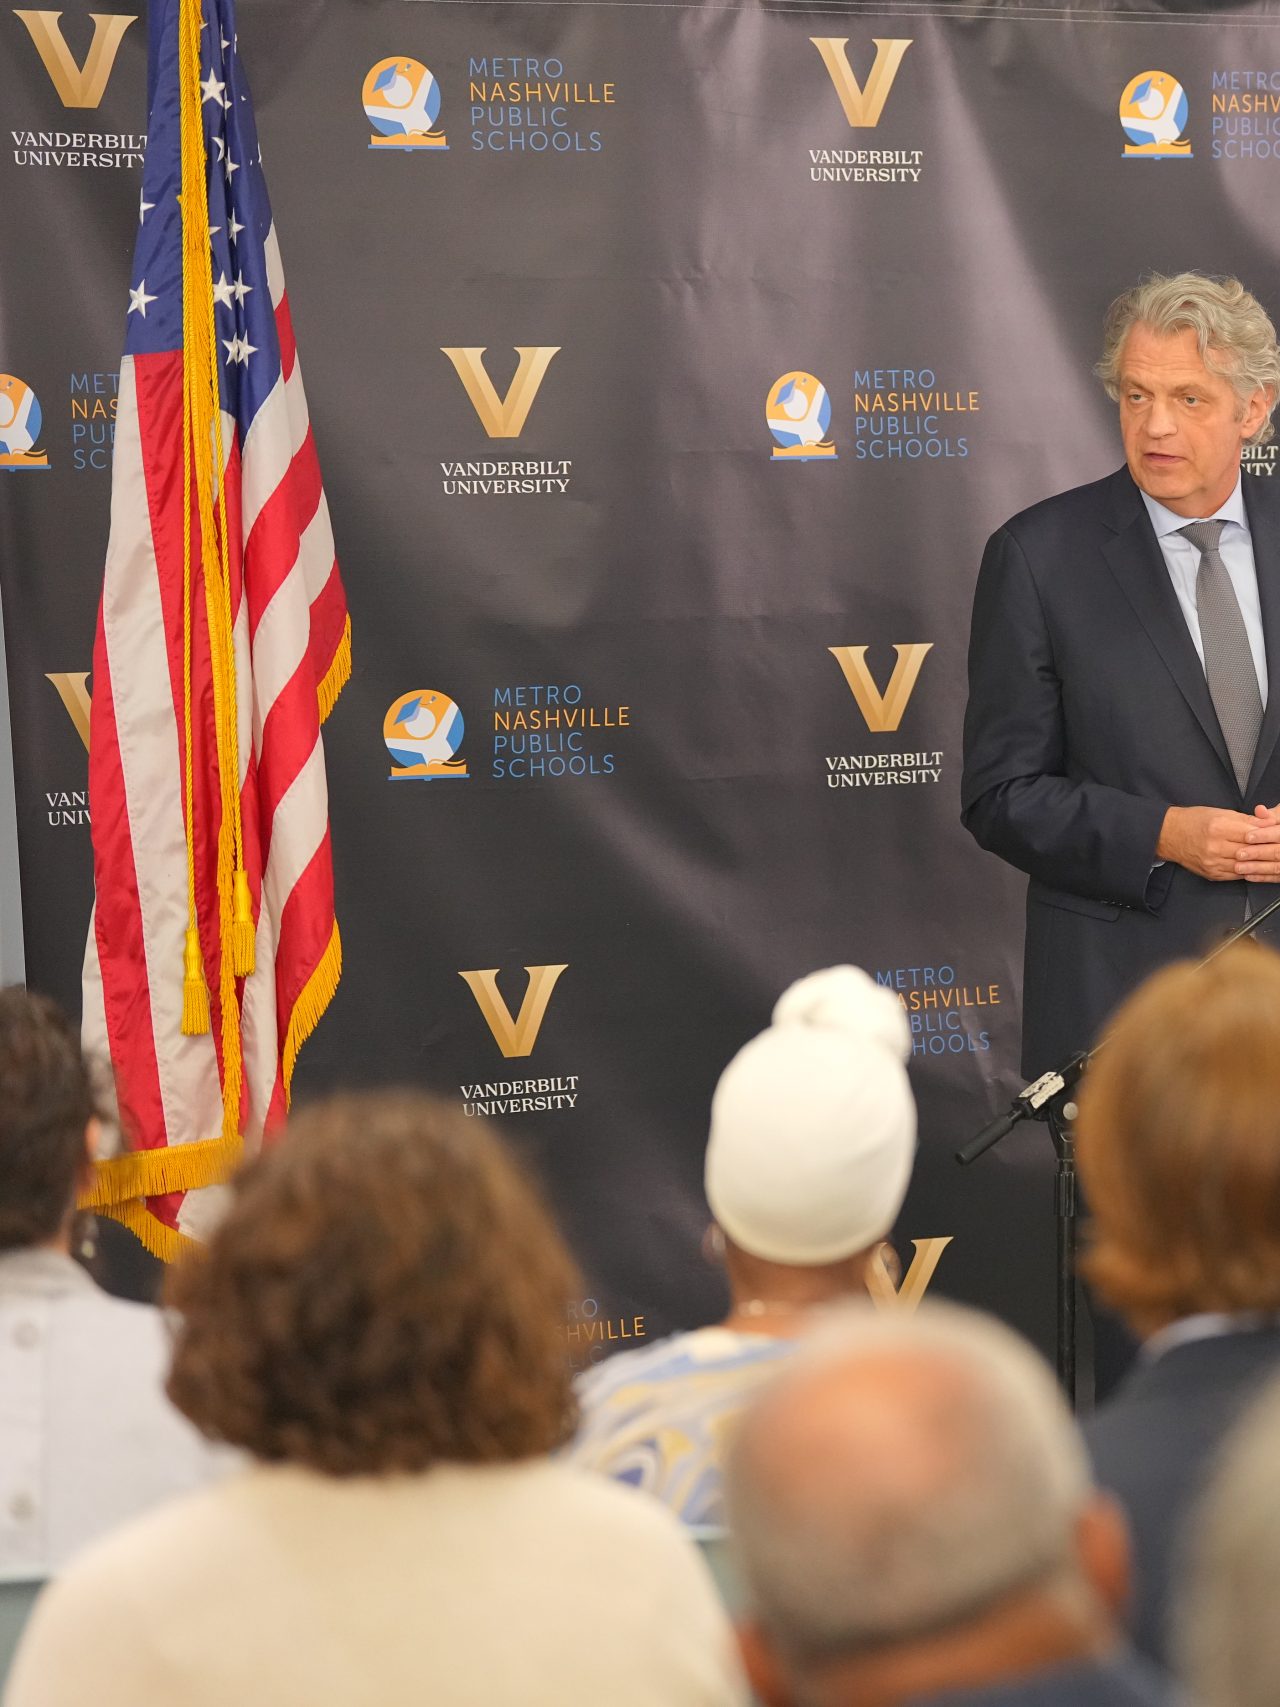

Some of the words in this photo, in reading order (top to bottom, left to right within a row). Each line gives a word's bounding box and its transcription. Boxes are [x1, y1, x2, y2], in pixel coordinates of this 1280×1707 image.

[12, 9, 140, 110] V
[470, 58, 563, 78] METRO
[471, 82, 616, 104] NASHVILLE
[808, 37, 914, 128] V
[471, 106, 567, 128] PUBLIC
[471, 130, 602, 152] SCHOOLS
[809, 150, 923, 165] VANDERBILT
[810, 167, 922, 183] UNIVERSITY
[854, 370, 935, 390] METRO
[440, 346, 562, 438] V
[854, 391, 980, 413] NASHVILLE
[855, 415, 938, 436] PUBLIC
[856, 437, 969, 459] SCHOOLS
[440, 460, 572, 478] VANDERBILT
[442, 478, 571, 495] UNIVERSITY
[493, 685, 582, 707] METRO
[828, 643, 934, 733] V
[494, 706, 630, 731] NASHVILLE
[494, 732, 583, 755] PUBLIC
[492, 754, 615, 778] SCHOOLS
[825, 751, 944, 770] VANDERBILT
[827, 769, 942, 788] UNIVERSITY
[875, 965, 955, 989] METRO
[897, 984, 1001, 1011] ASHVILLE
[458, 965, 569, 1059] V
[910, 1011, 961, 1033] BLIC
[911, 1031, 991, 1057] HOOLS
[460, 1076, 579, 1099] VANDERBILT
[463, 1094, 578, 1117] UNIVERSITY
